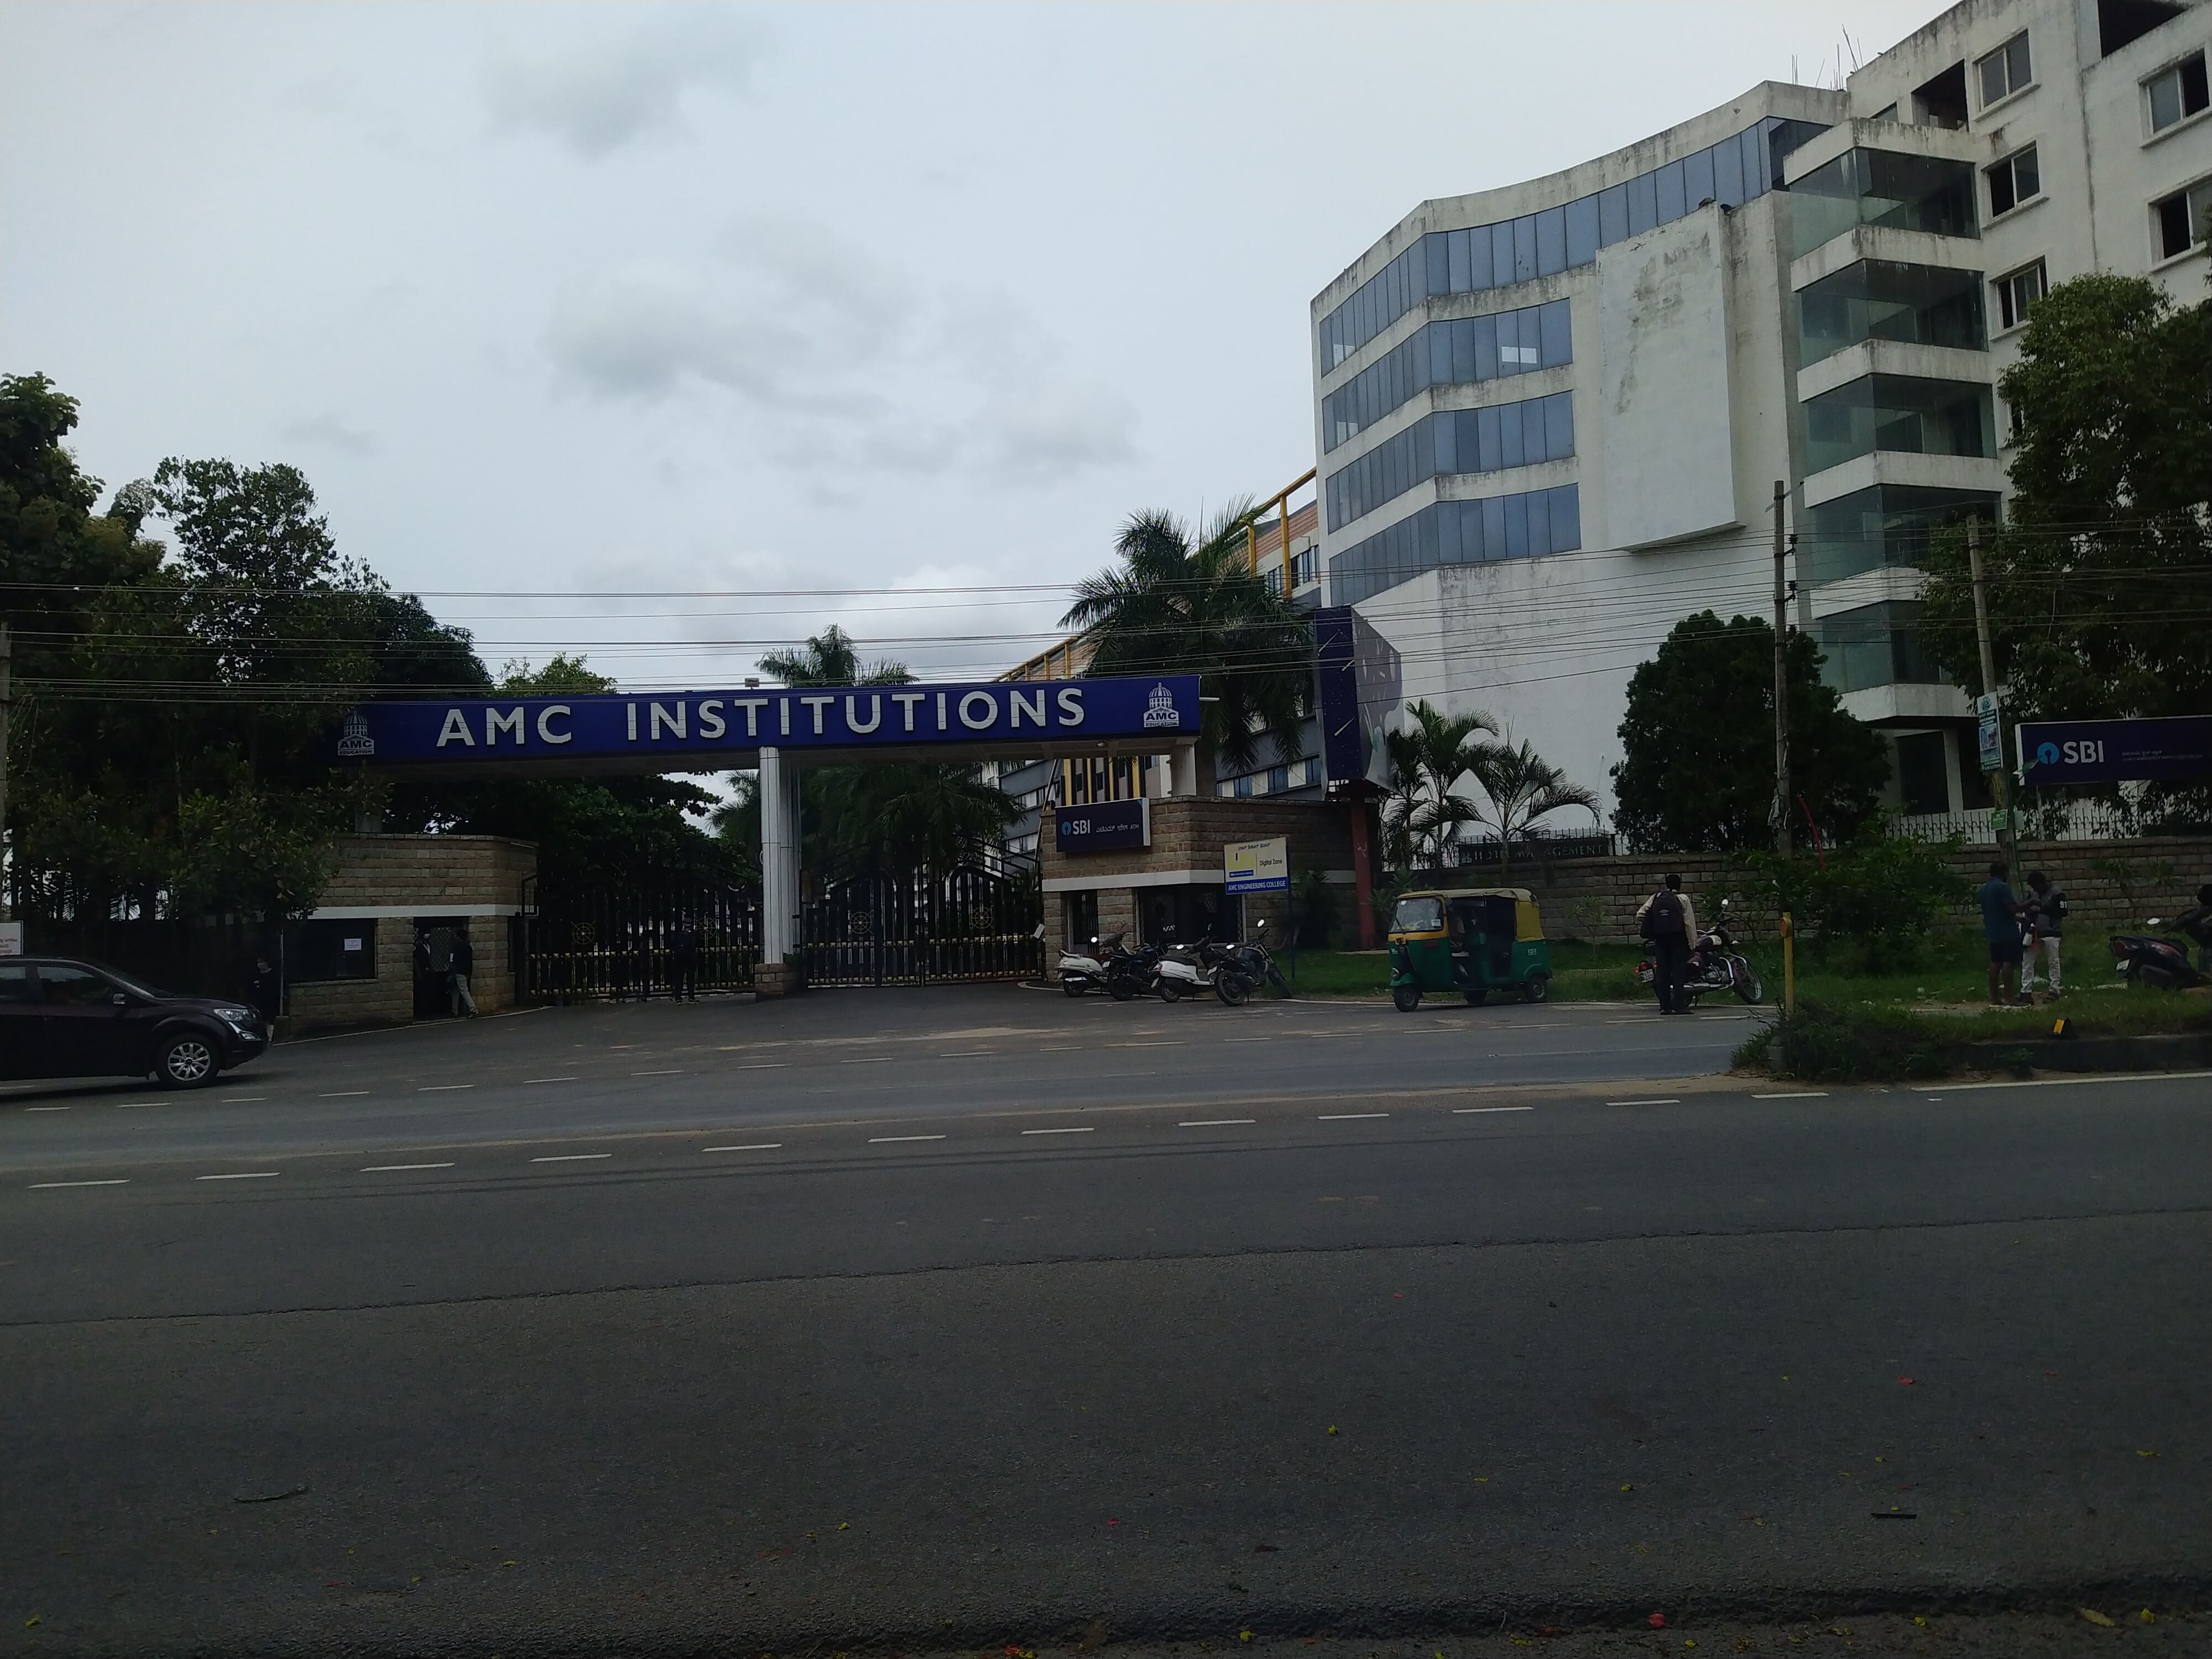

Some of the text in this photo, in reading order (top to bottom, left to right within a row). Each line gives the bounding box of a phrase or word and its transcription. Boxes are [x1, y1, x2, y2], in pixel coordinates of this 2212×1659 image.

[436, 688, 1084, 747] AMC INSTITUTIONS
[1146, 712, 1177, 721] AMC
[340, 740, 372, 749] AMC
[2063, 740, 2104, 764] SBI
[1072, 819, 1091, 835] SBI
[1516, 844, 1603, 858] MAAGEMENT
[1238, 882, 1266, 890] ENGINEERING
[2059, 900, 2068, 909] 91
